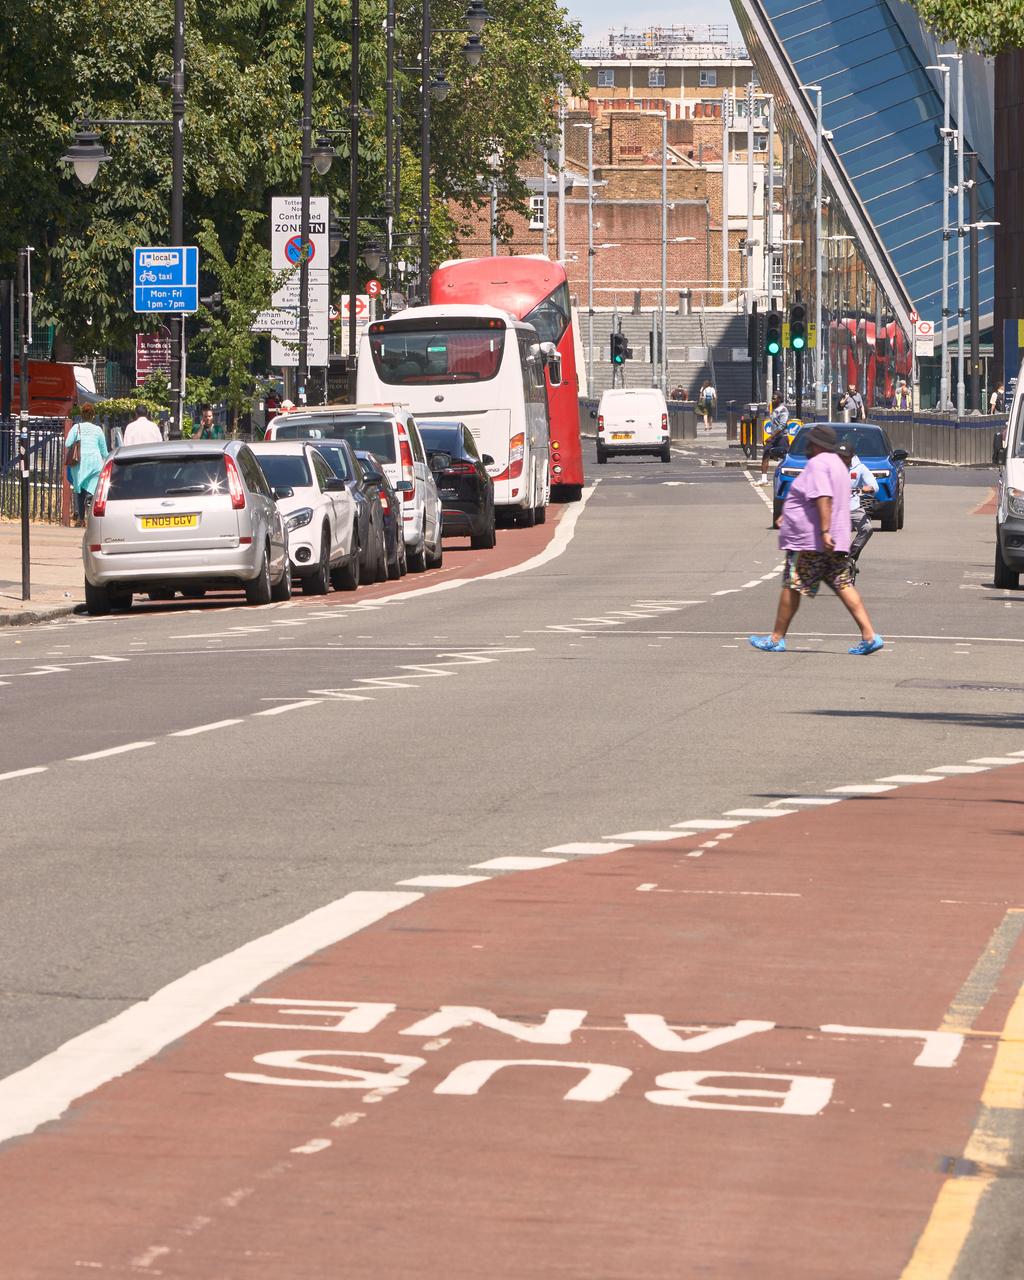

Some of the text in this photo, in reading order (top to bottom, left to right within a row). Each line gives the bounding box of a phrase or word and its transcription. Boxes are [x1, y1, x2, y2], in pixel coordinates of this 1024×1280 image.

[309, 223, 323, 233] TN
[152, 253, 171, 261] local
[369, 281, 378, 293] S
[150, 290, 167, 298] Mon
[172, 289, 183, 298] Fri
[910, 312, 918, 321] N
[145, 515, 193, 527] FN09 GGV
[214, 998, 965, 1068] LANE
[224, 1049, 836, 1116] BUS
